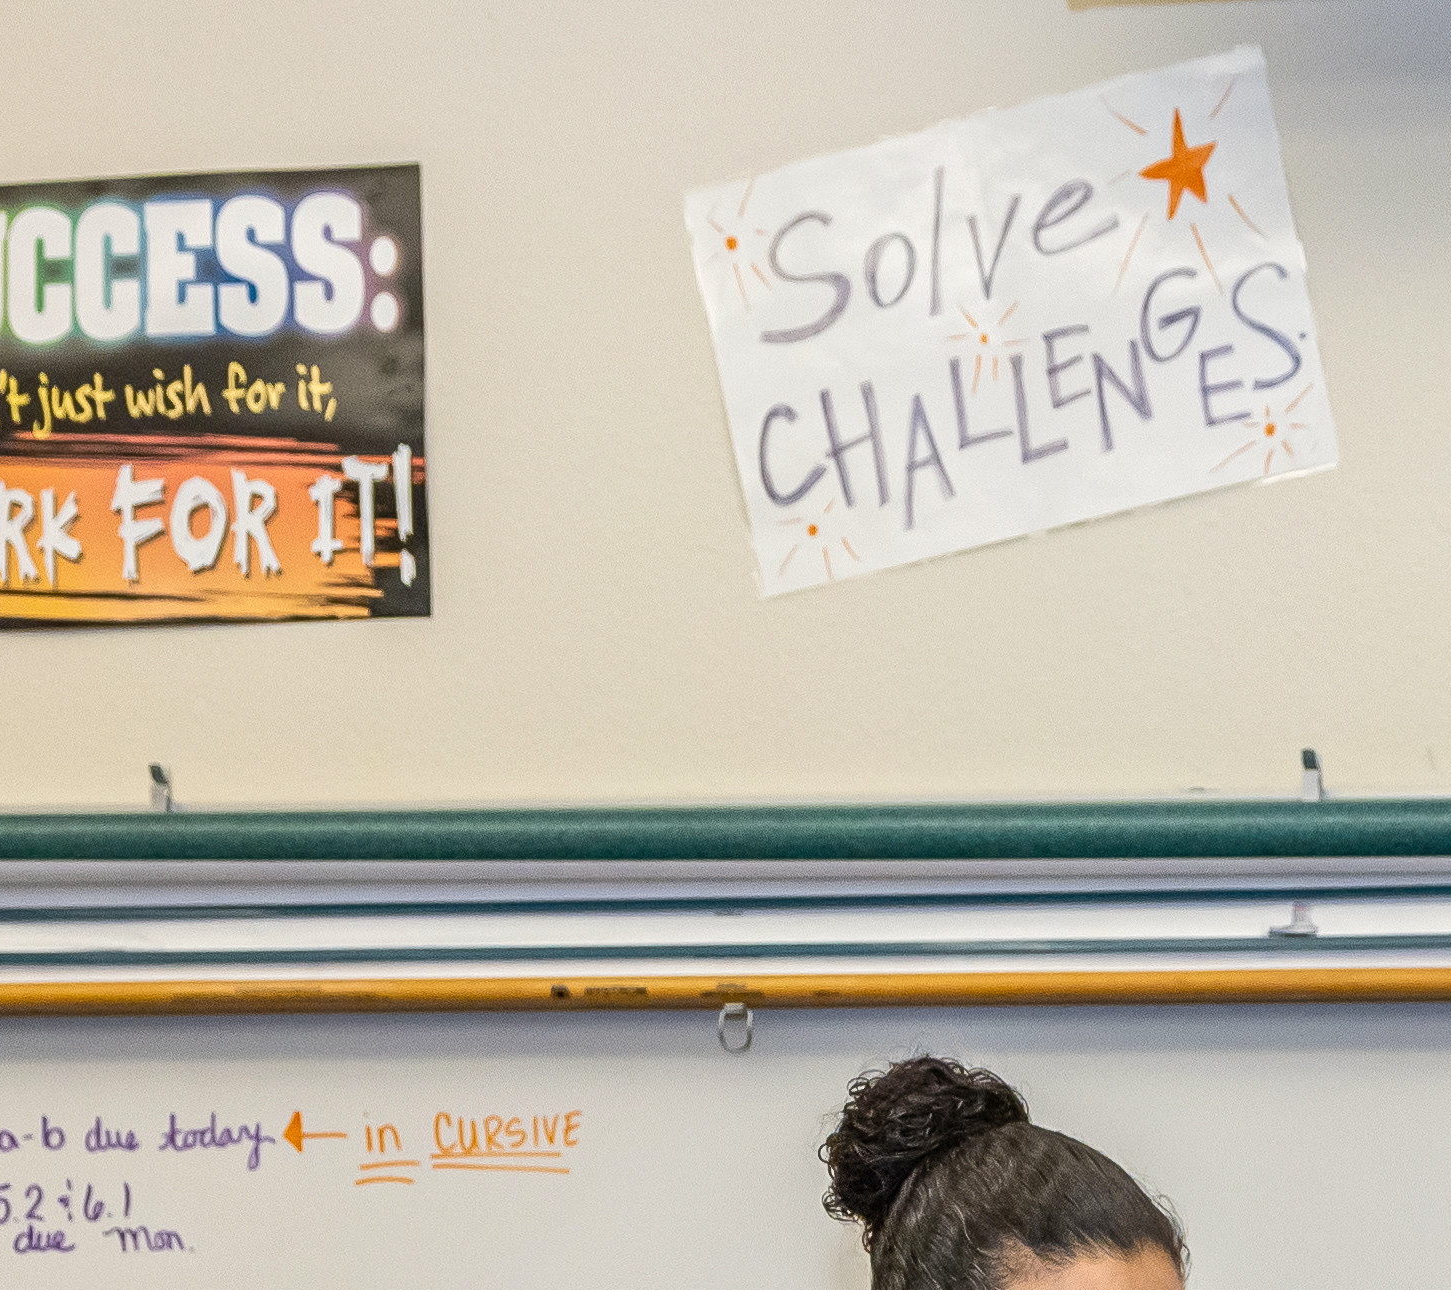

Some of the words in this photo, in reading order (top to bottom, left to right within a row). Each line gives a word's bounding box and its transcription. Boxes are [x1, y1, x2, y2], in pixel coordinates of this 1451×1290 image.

[760, 165, 1120, 343] Solve
[33, 372, 114, 440] just
[125, 365, 211, 420] wish
[223, 362, 287, 416] for
[297, 365, 337, 421] it,
[111, 464, 283, 581] FOR
[310, 442, 414, 586] IT!
[85, 1115, 140, 1153] due
[160, 1112, 276, 1170] today
[364, 1112, 403, 1154] in
[433, 1110, 582, 1155] CURSIVE
[13, 1225, 76, 1254] due
